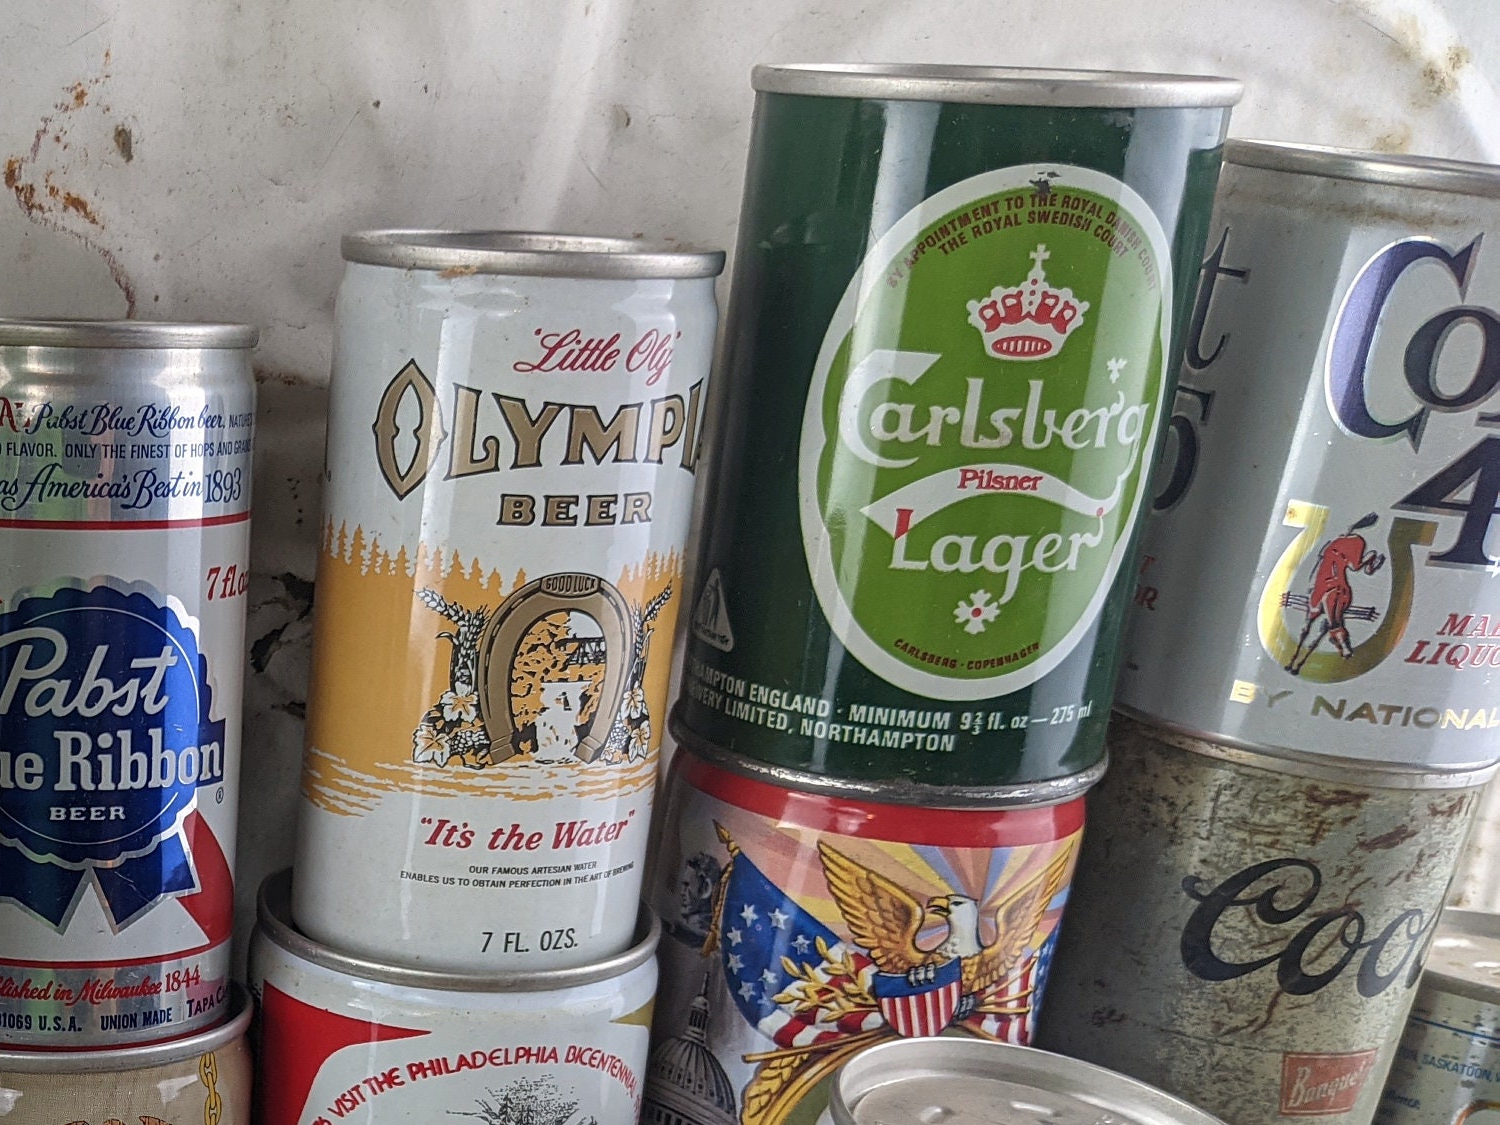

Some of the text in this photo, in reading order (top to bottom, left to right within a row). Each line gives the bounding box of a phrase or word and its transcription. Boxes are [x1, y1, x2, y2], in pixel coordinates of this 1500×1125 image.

[903, 192, 1104, 274] APPOINTMENT THE ROYAL
[939, 209, 1092, 257] THE ROYAL SWEDISH
[1324, 232, 1500, 454] Co
[25, 401, 87, 435] Pabst
[372, 358, 705, 502] OLYMPI
[837, 347, 1150, 482] Carlsberg
[6, 442, 58, 458] FLAVOR.
[64, 443, 99, 459] ONLY
[101, 443, 127, 459] THE
[130, 443, 171, 459] FINEST
[174, 442, 188, 458] OF
[120, 466, 183, 509] Best
[204, 467, 243, 504] 1893
[956, 468, 1044, 492] Pilsner
[496, 492, 653, 527] BEER
[888, 507, 1104, 606] Lager
[546, 576, 598, 592] GOOD LUCK
[893, 637, 1041, 671] CARLSBERG COPENHAGEN
[749, 683, 830, 719] ENGLAND
[849, 703, 951, 732] MINIMUM
[799, 717, 957, 753] NORTHAMPTON
[53, 727, 222, 792] Ribbon
[49, 804, 127, 822] BEER
[487, 823, 543, 851] the
[400, 870, 562, 889] ENABLES OBTAIN PERFECTION
[491, 863, 573, 876] FAMOUS ARTESIAN
[481, 927, 579, 953] 7 OZS.
[1180, 857, 1454, 998] Coo
[65, 975, 162, 1007] Milwaukee
[165, 964, 201, 994] 1844
[38, 1014, 83, 1033] U.S.A.
[100, 1006, 173, 1032] UNION MADE
[327, 1083, 366, 1119] VISIT
[362, 1066, 406, 1098] THE
[405, 1045, 559, 1082] PHILADELPHIA
